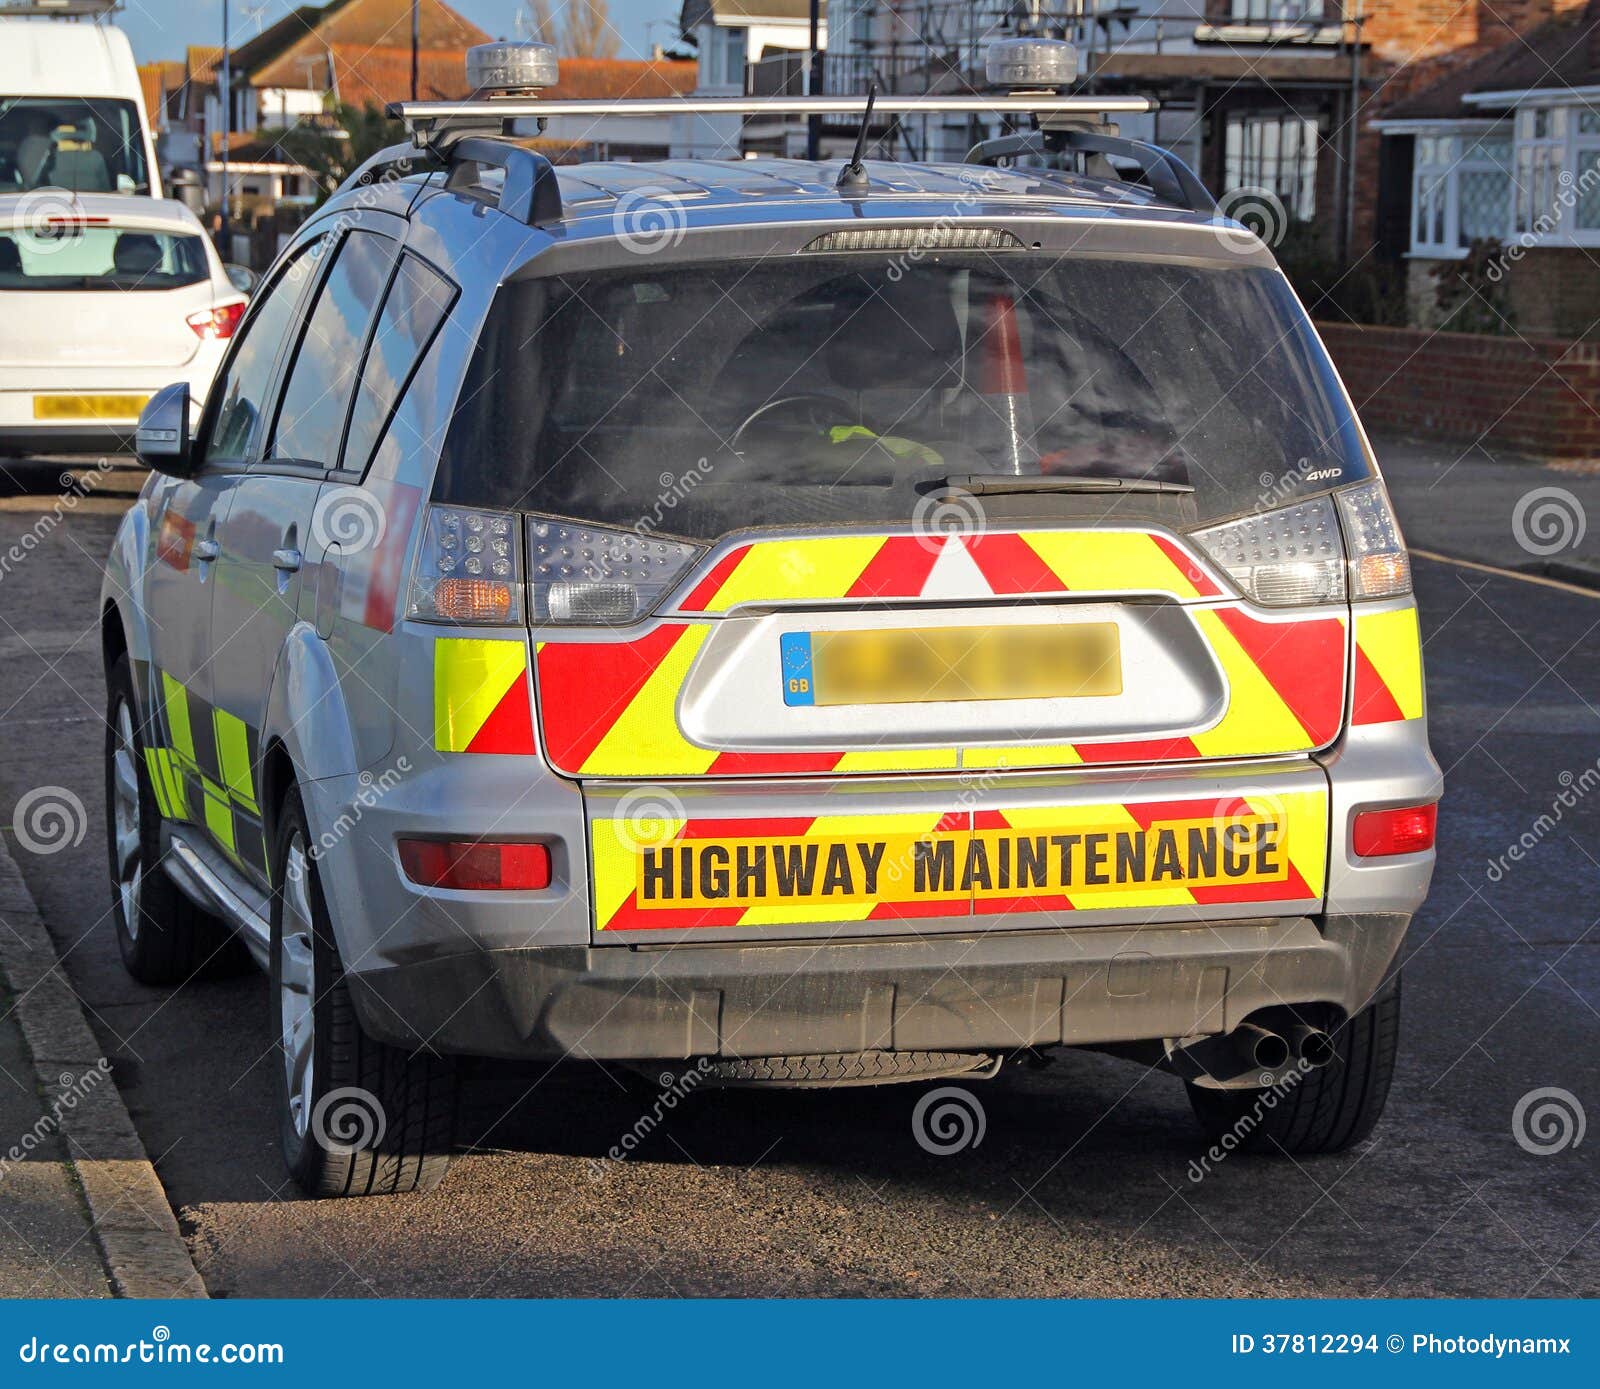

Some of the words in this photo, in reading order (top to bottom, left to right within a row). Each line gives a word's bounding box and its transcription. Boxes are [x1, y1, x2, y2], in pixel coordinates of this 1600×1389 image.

[1305, 468, 1343, 481] 4WD
[789, 678, 809, 693] GB
[643, 842, 886, 900] HIGHWAY
[913, 822, 1280, 893] MAINTENANCE
